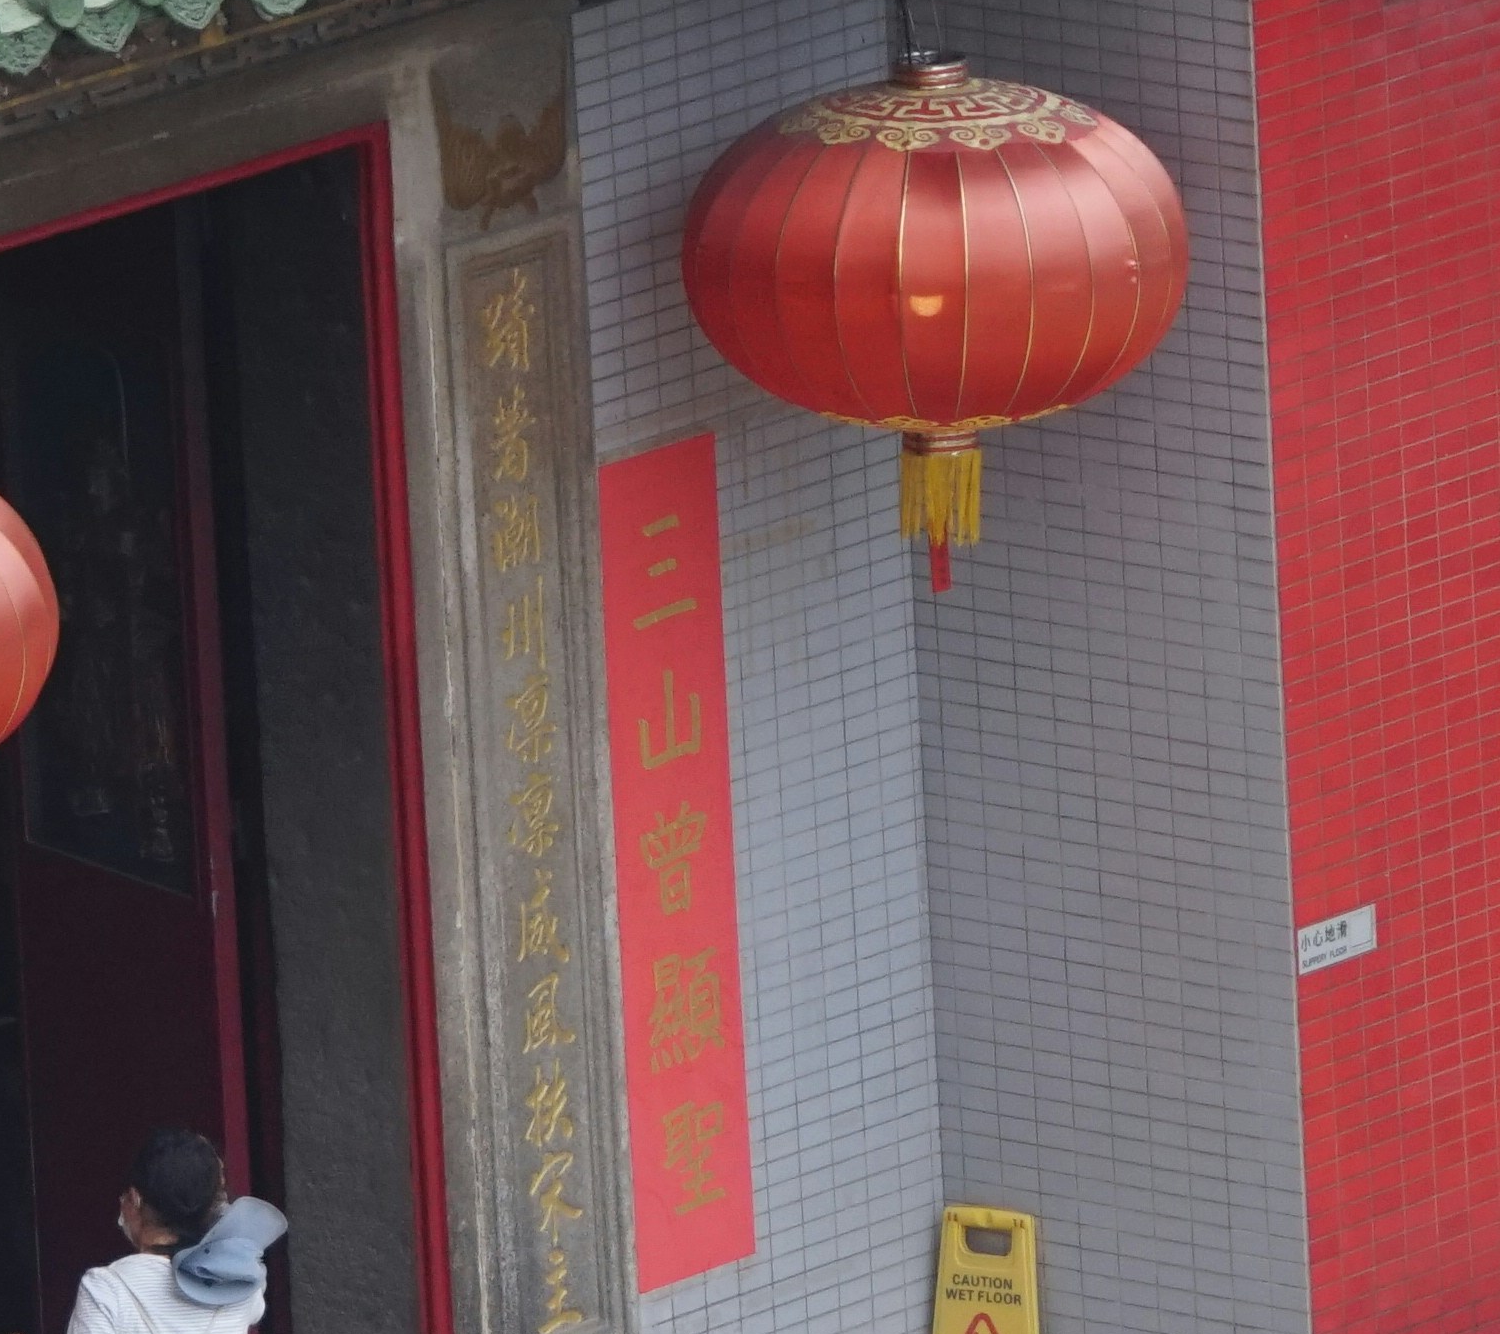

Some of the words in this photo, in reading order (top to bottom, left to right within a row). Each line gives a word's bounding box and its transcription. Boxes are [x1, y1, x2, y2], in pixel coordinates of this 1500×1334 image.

[633, 514, 727, 1218] 三山曾顯聖
[1301, 920, 1348, 952] 小心地滑
[952, 1273, 1013, 1290] CAUTION
[945, 1288, 975, 1303] WET
[977, 1290, 1022, 1306] FLOOR
